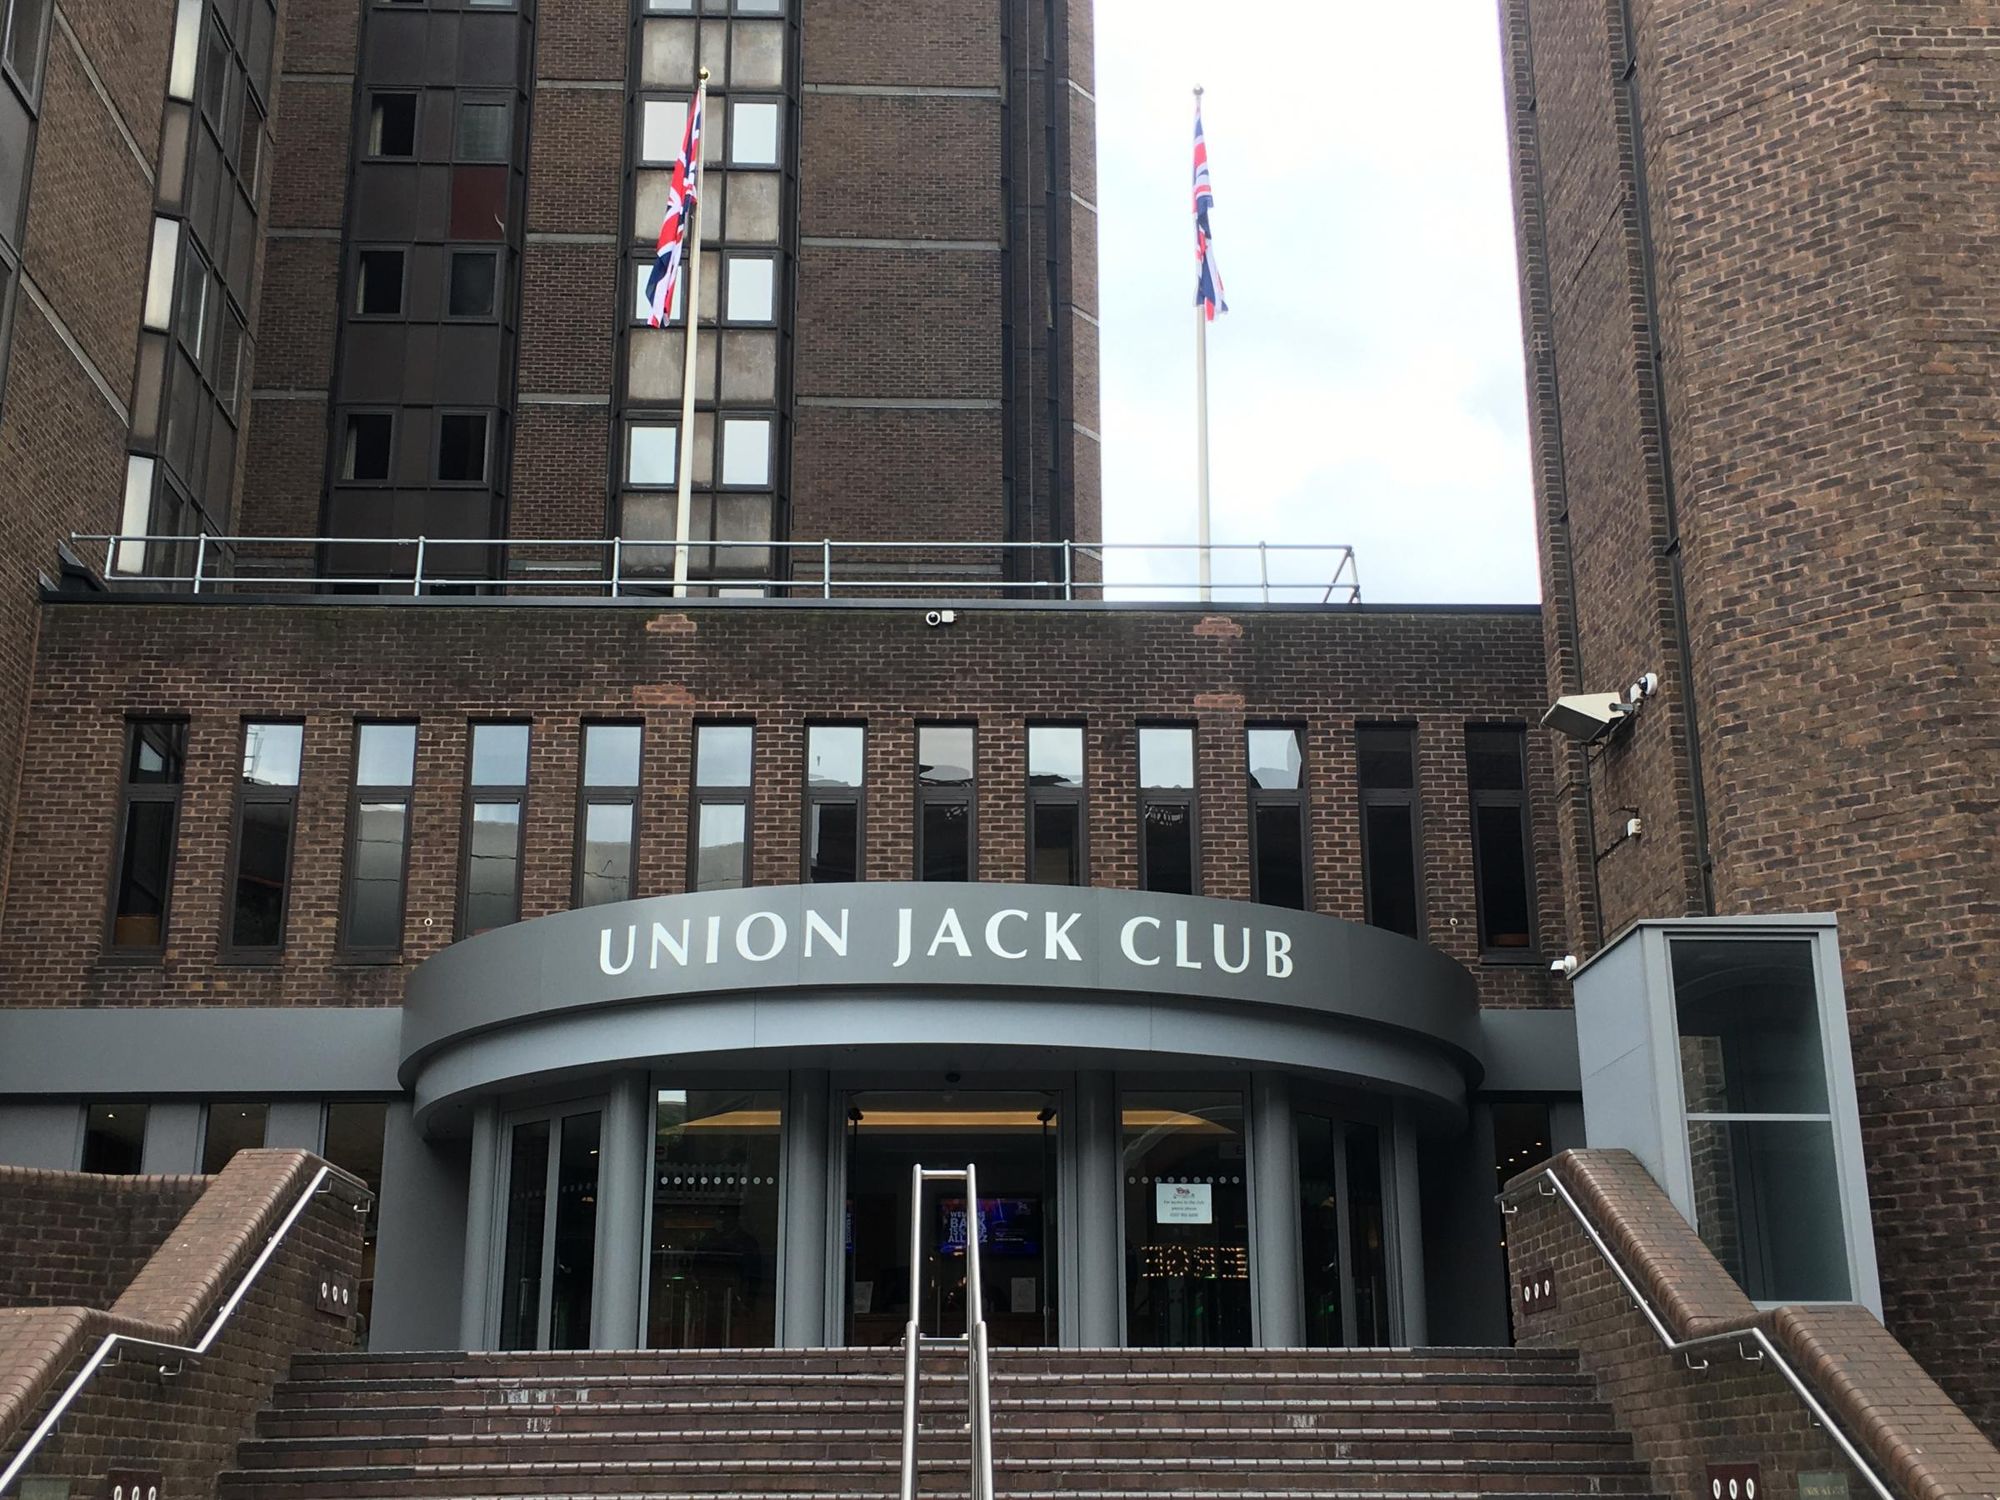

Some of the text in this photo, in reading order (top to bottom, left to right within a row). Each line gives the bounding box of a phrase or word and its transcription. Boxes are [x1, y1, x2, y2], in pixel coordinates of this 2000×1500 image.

[599, 907, 1294, 978] UNION JACK CLUB
[950, 1218, 987, 1228] BAK
